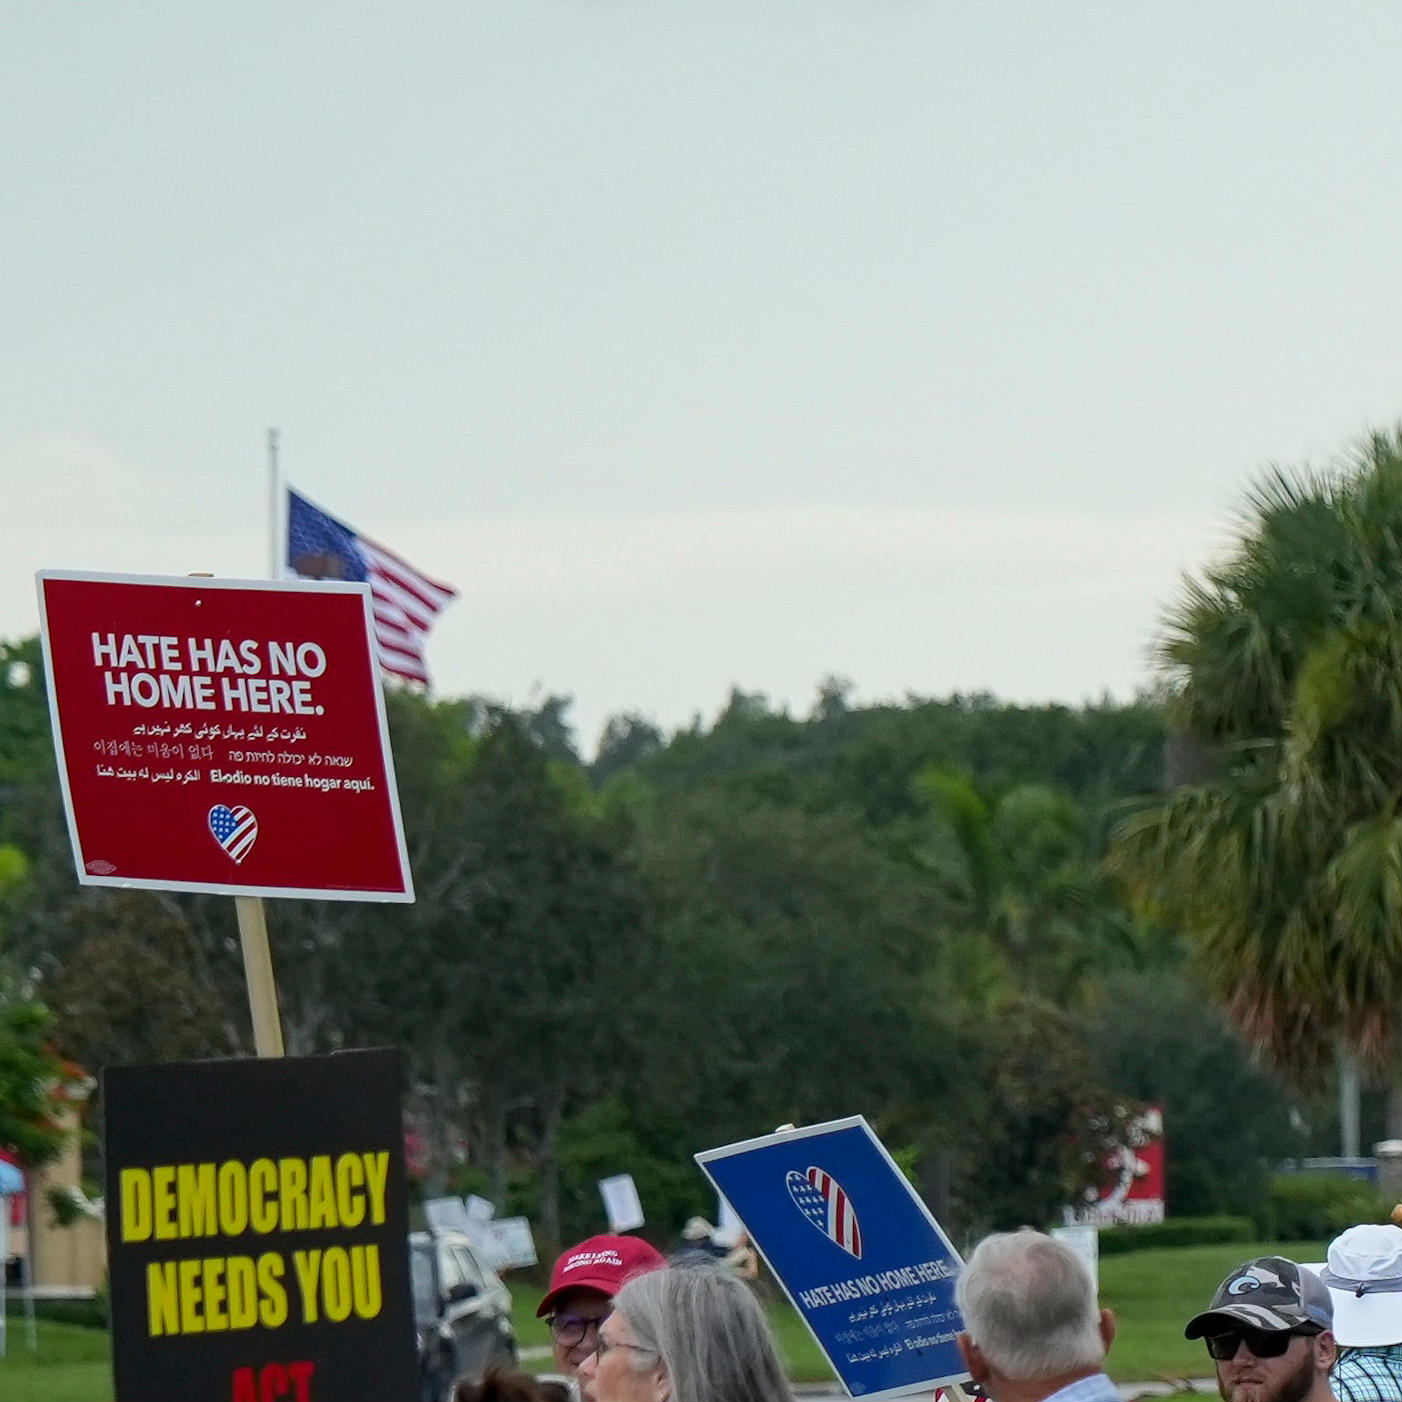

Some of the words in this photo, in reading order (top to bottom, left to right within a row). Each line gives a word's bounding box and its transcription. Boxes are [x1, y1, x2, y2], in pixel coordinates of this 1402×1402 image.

[91, 632, 182, 671] HATE
[188, 637, 262, 674] HAS
[268, 641, 328, 679] NO
[104, 671, 216, 710] HOME
[221, 677, 325, 716] HERE.
[254, 774, 270, 785] no
[271, 772, 303, 787] tiene
[304, 774, 340, 792] hogar
[120, 1151, 390, 1243] DEMOCRACY
[147, 1252, 288, 1337] NEEDS
[294, 1244, 382, 1324] YOU
[799, 1285, 837, 1309] HATE
[833, 1280, 861, 1302] HAS
[857, 1275, 880, 1296] NO
[876, 1266, 920, 1292] HOME
